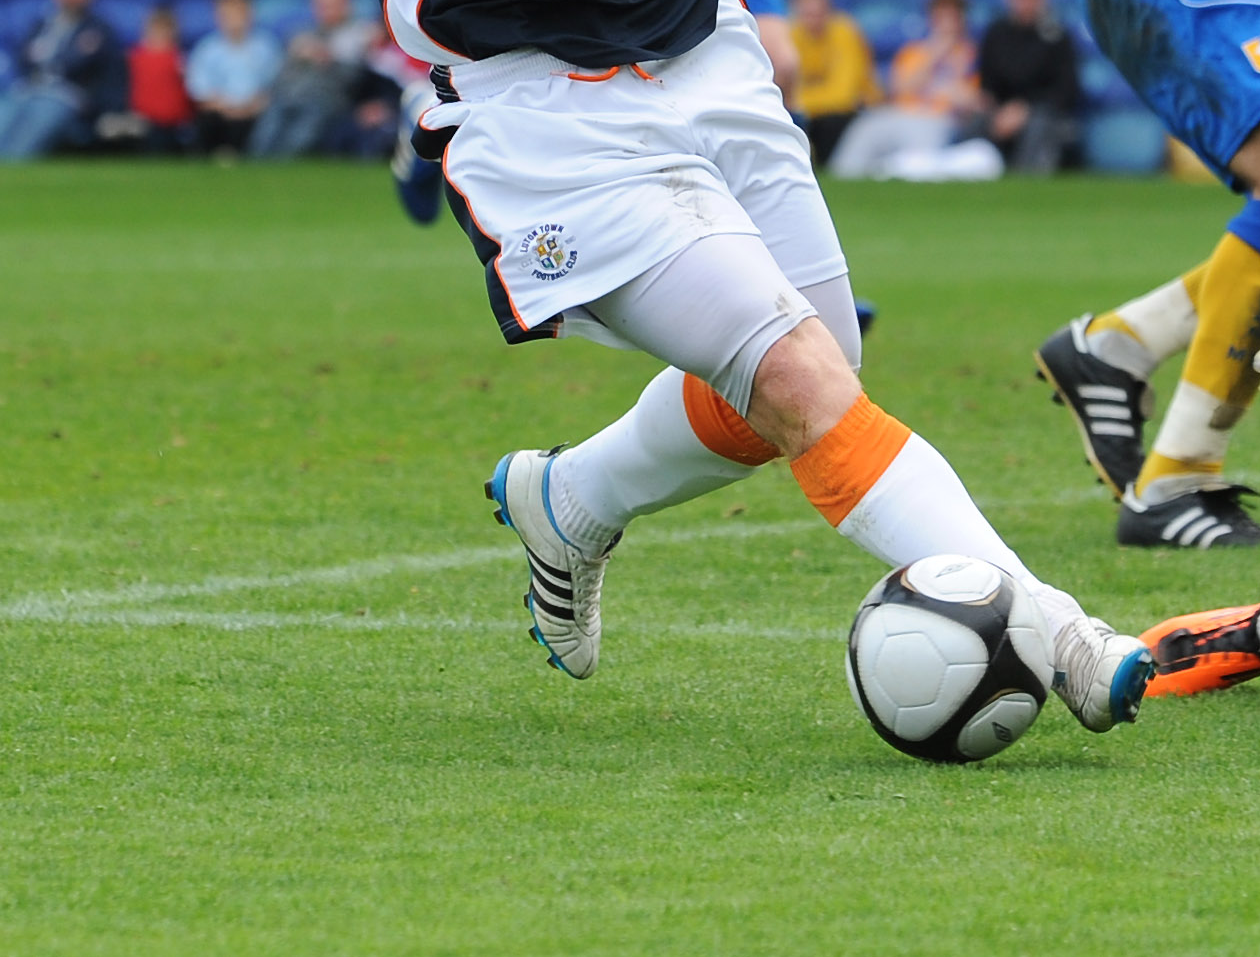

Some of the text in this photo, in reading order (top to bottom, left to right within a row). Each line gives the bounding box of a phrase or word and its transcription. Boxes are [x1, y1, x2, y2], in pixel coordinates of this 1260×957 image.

[539, 223, 565, 234] TOWN
[531, 250, 578, 281] FOOTBALL CLUB
